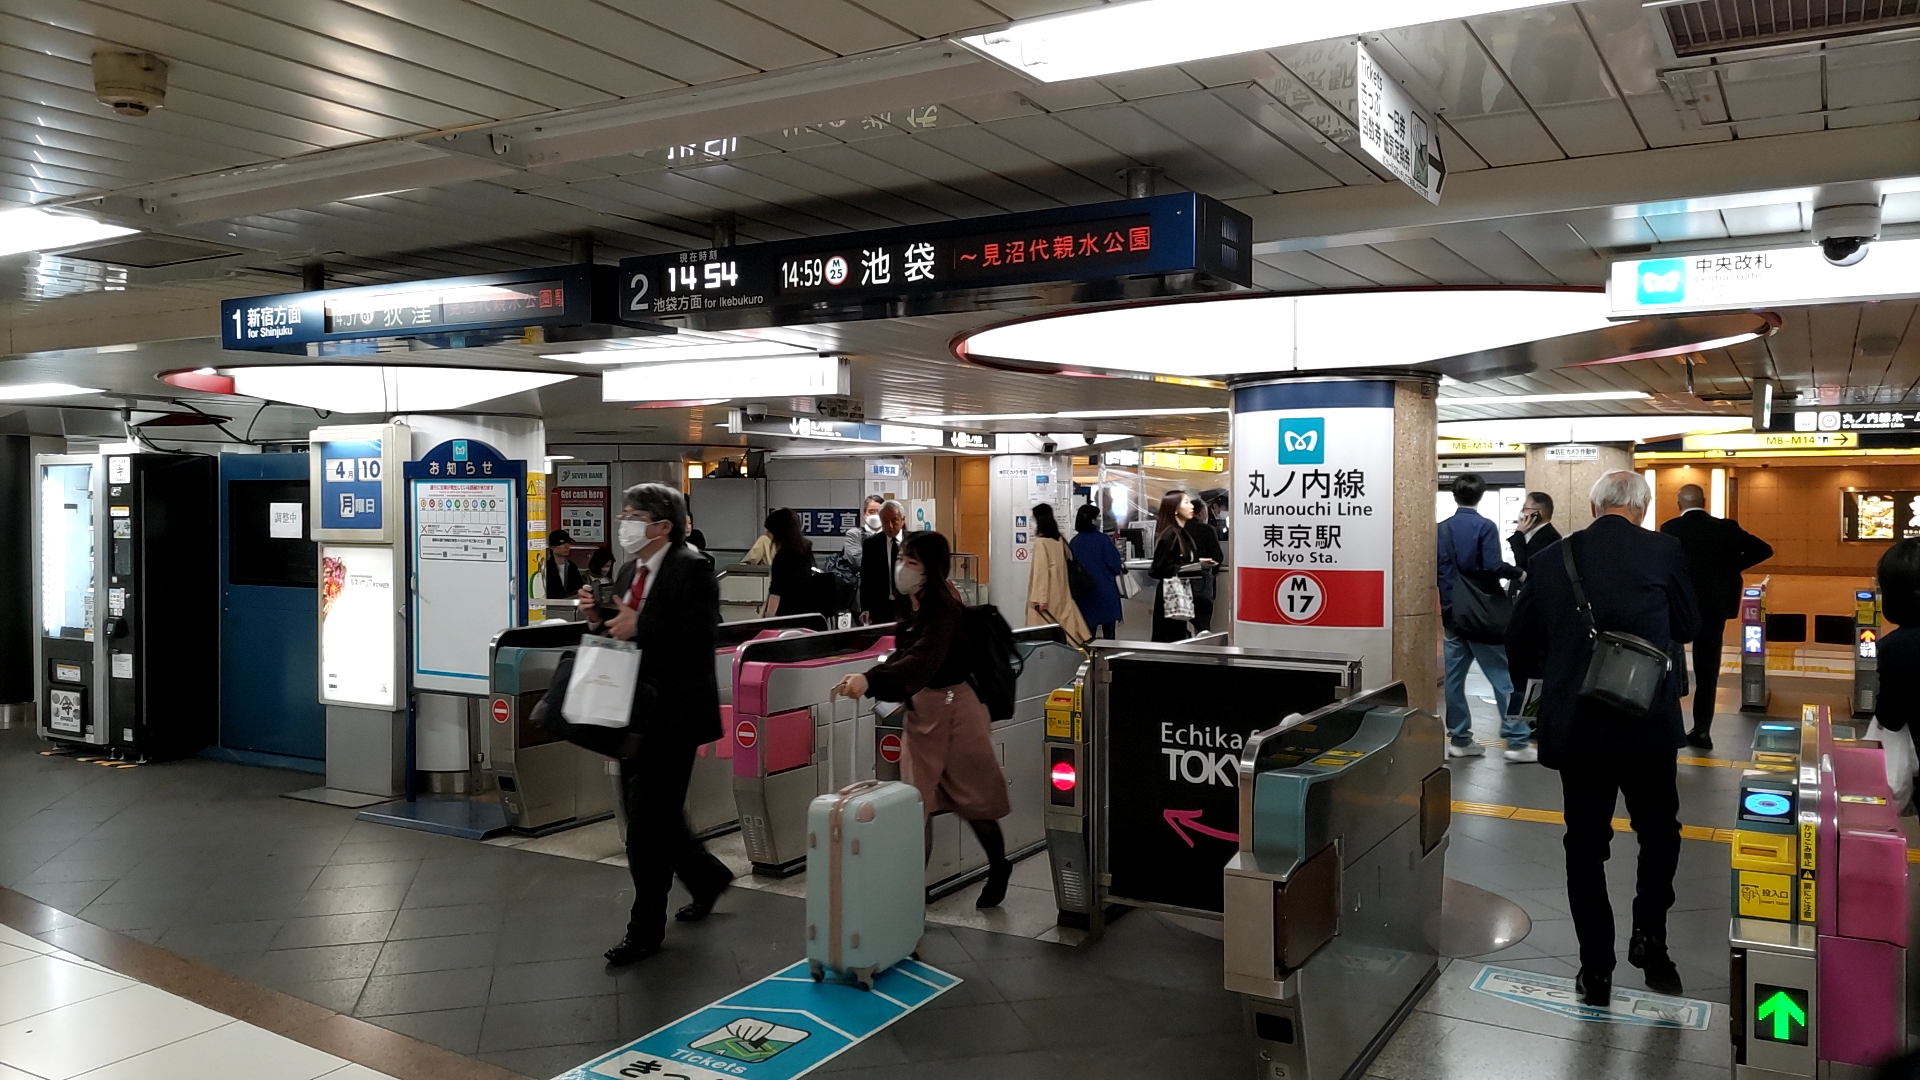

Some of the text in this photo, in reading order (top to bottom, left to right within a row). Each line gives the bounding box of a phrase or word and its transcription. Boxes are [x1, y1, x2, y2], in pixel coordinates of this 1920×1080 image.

[1360, 55, 1383, 92] Tickets
[679, 250, 718, 263] 現在時刻
[860, 242, 936, 286] 池袋
[1696, 254, 1773, 273] 中央改札
[782, 258, 823, 289] 14:59
[829, 269, 843, 280] 25
[630, 274, 649, 311] 2
[653, 294, 764, 313] 池袋方面 for Ikebukuro
[232, 308, 241, 339] 1
[247, 305, 302, 328] 新宿方面
[247, 326, 293, 338] for Shinjuku
[362, 460, 381, 479] 10
[429, 461, 493, 475] お知らせ
[571, 472, 588, 480] SEVEN
[1248, 469, 1366, 499] 丸ノ内線
[560, 490, 604, 499] Get cash here
[274, 512, 297, 524] 調整中
[1244, 502, 1373, 516] Marunouchi Line
[1263, 524, 1342, 549] 東京駅
[1265, 551, 1338, 565] Tokyo Sta.
[1291, 577, 1308, 592] M
[1287, 595, 1315, 613] 17
[1161, 722, 1243, 750] Echika
[1803, 825, 1813, 868] かけこみ禁止
[1762, 889, 1789, 899] 投入口
[670, 1048, 748, 1074] Tickets
